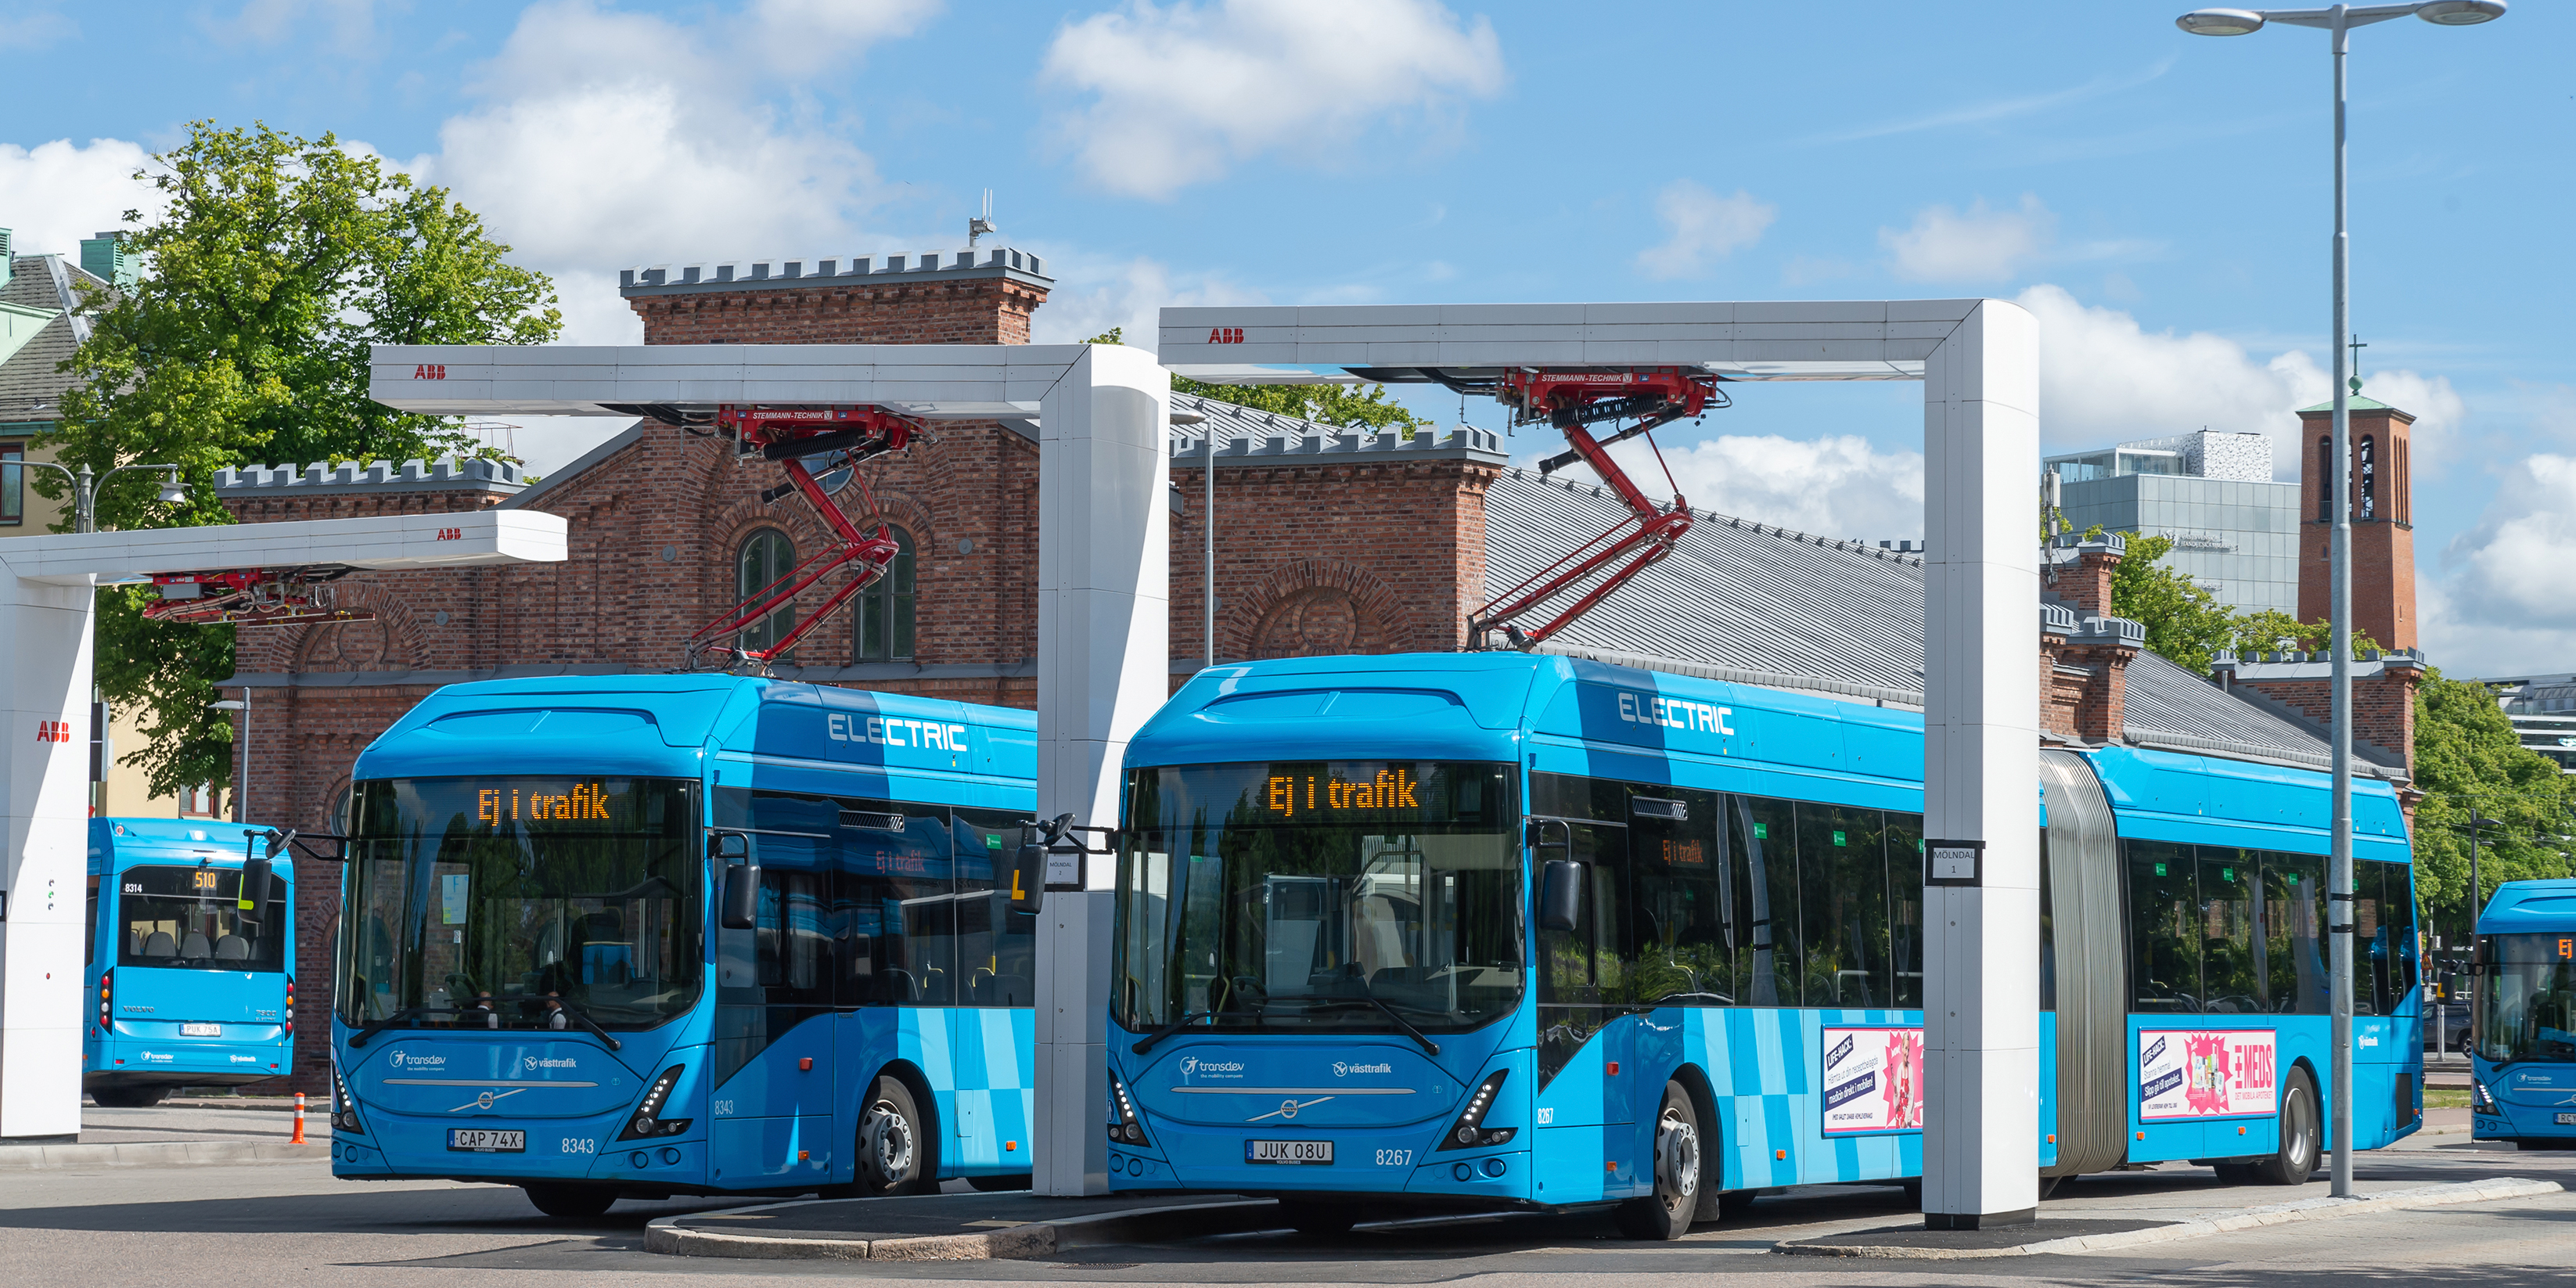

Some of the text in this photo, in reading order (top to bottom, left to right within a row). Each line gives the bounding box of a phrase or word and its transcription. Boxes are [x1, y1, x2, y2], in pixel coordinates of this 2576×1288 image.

[1207, 328, 1244, 344] ABB
[414, 365, 446, 380] ABB
[753, 411, 824, 419] STEMMANN-TECHNIK
[437, 527, 462, 541] ABB
[1618, 693, 1735, 736] ELECTRIC
[37, 721, 70, 743] ABB
[828, 713, 967, 752] ELECTRIC
[1269, 769, 1419, 817] Ej i trafik
[479, 783, 610, 826] Ej i trafik
[1663, 840, 1671, 865] Ej
[1679, 840, 1704, 863] trafik
[1934, 851, 1974, 859] MÖLNDAL
[896, 850, 925, 872] trafik
[196, 872, 216, 887] 510
[125, 883, 142, 893] 8314
[2559, 939, 2572, 959] Ej
[406, 1055, 446, 1064] transdev
[539, 1058, 577, 1067] västtrafik
[1199, 1061, 1244, 1071] transdev
[2244, 1045, 2272, 1088] MEDS
[1350, 1063, 1391, 1073] västtrafik
[714, 1100, 733, 1114] 8343
[1538, 1108, 1553, 1124] 8267
[460, 1131, 517, 1147] CAP 74X
[562, 1138, 594, 1153] 8343
[1260, 1143, 1325, 1159] JUK 08U
[1376, 1149, 1412, 1166] 8267
